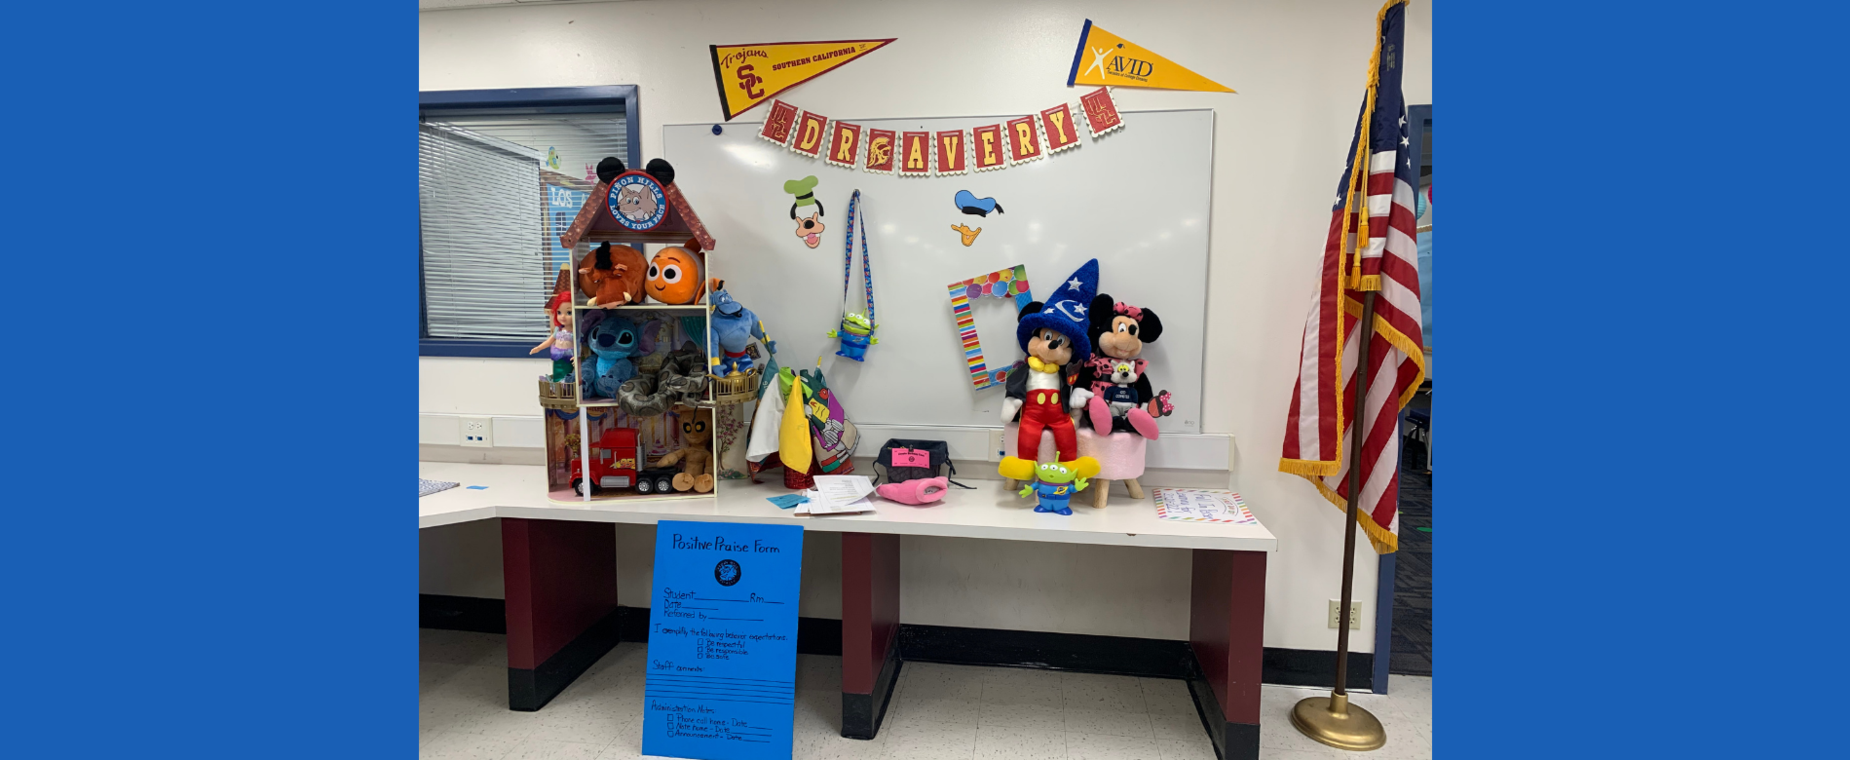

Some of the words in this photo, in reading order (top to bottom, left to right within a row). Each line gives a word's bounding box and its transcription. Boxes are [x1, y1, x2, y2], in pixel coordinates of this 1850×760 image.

[720, 48, 768, 68] Trojans
[772, 56, 811, 71] SOUTHERN
[812, 46, 856, 62] CALIFORNIA
[1106, 56, 1153, 77] AVID
[736, 64, 765, 100] SC
[907, 111, 1068, 169] AVERY
[551, 187, 572, 208] LOS
[638, 176, 663, 199] HILLS
[610, 205, 630, 226] LOVES
[631, 222, 654, 230] YOUR
[654, 204, 665, 223] FACE
[673, 533, 713, 550] Positive
[715, 536, 749, 552] Praise
[754, 539, 780, 553] Form
[663, 587, 696, 600] Student
[664, 599, 682, 609] Date
[699, 612, 707, 622] by
[654, 623, 661, 633] I
[652, 659, 674, 670] Staff
[676, 713, 694, 723] Phone
